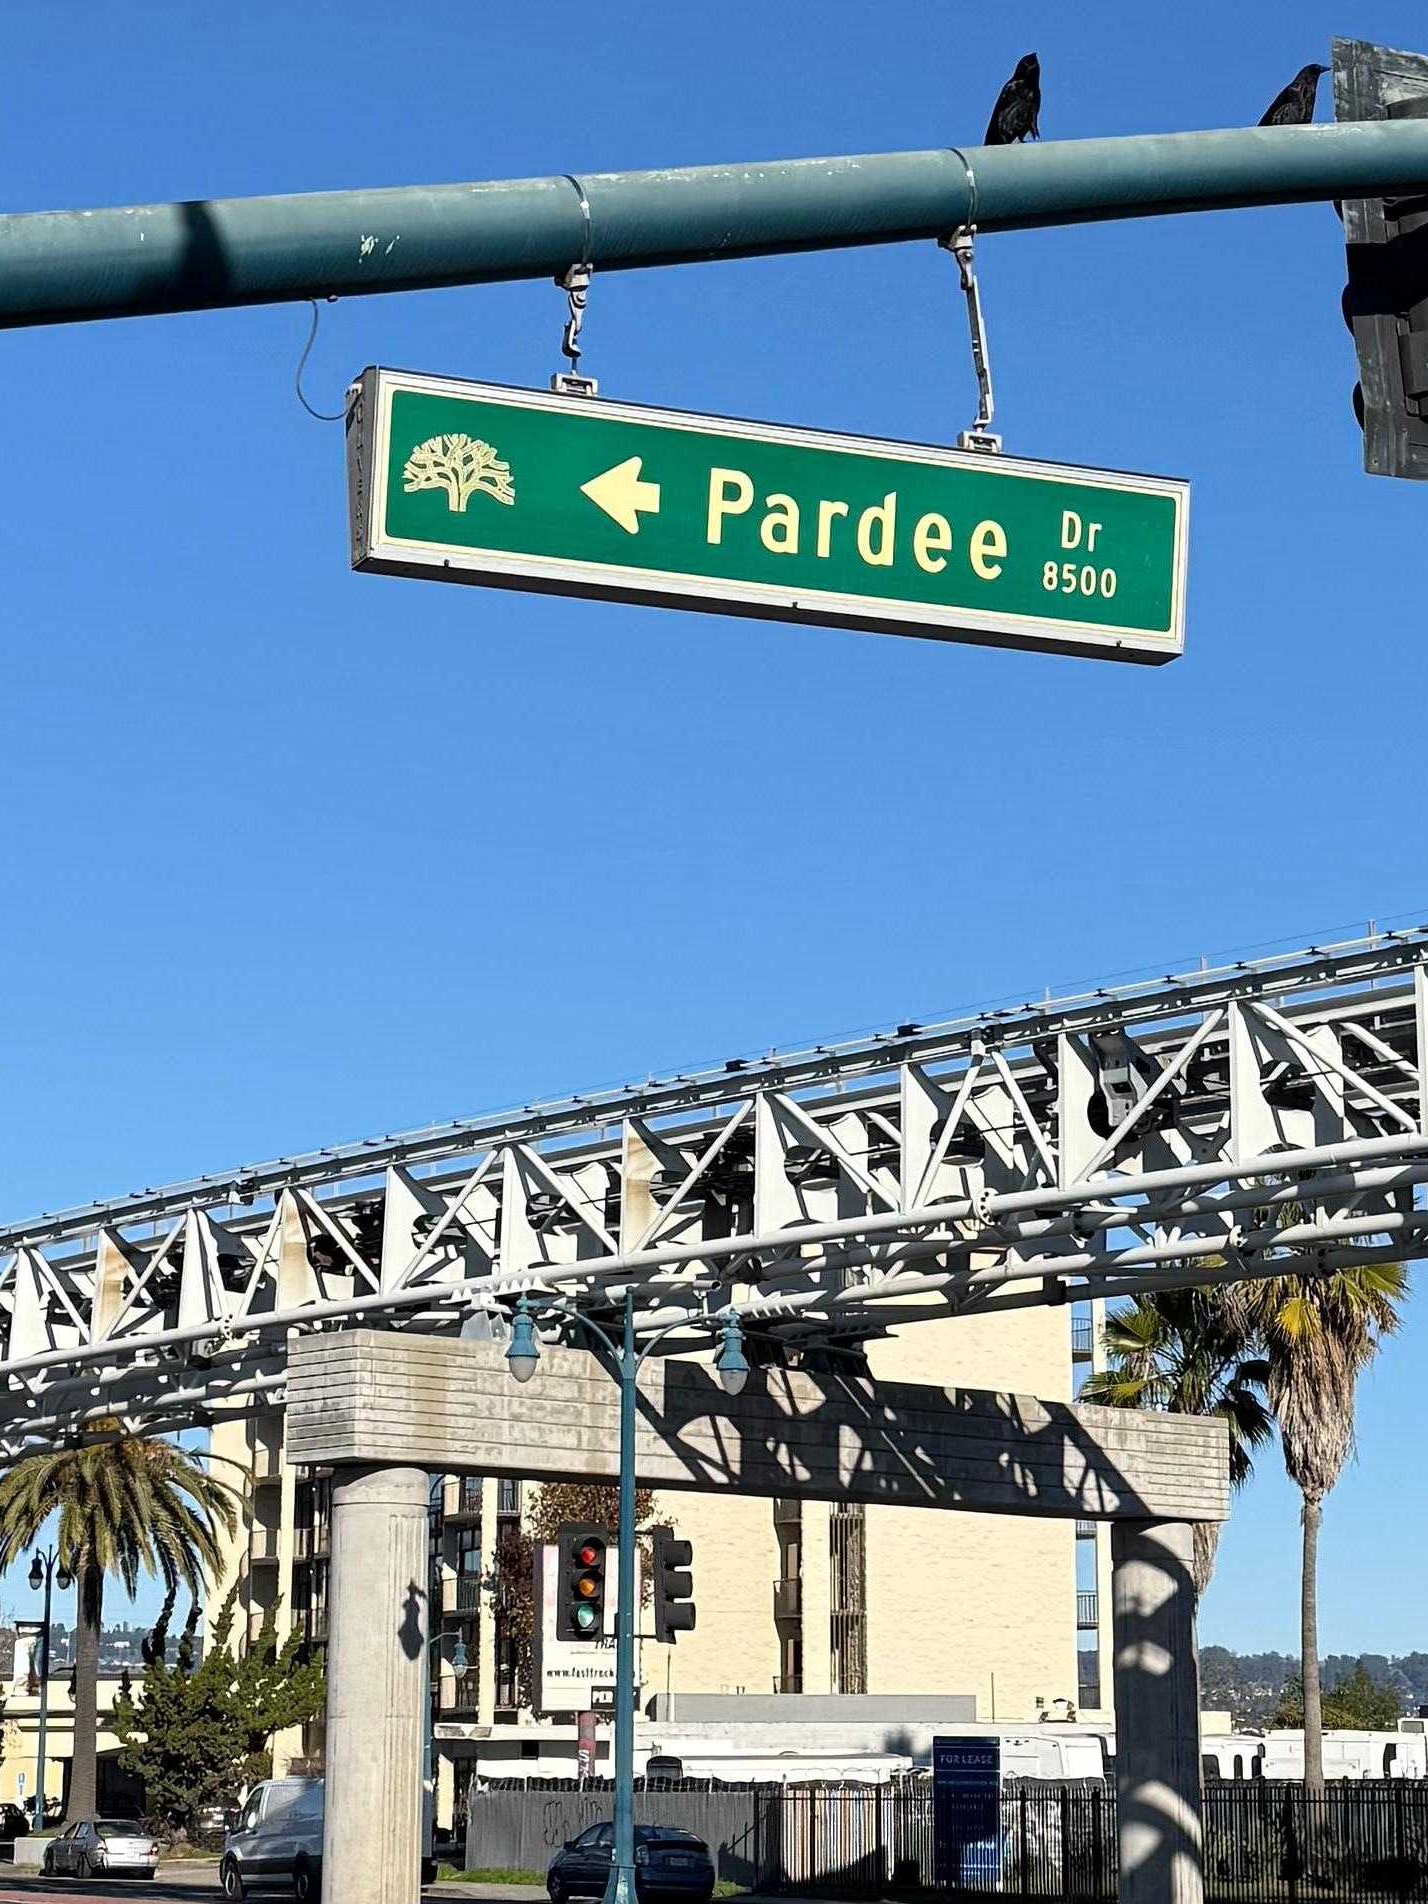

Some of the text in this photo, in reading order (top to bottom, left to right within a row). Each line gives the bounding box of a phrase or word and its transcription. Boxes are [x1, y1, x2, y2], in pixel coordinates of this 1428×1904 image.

[707, 467, 1103, 580] Pardee Dr
[1043, 560, 1117, 598] 8500
[940, 1754, 994, 1764] FOR LEASE
